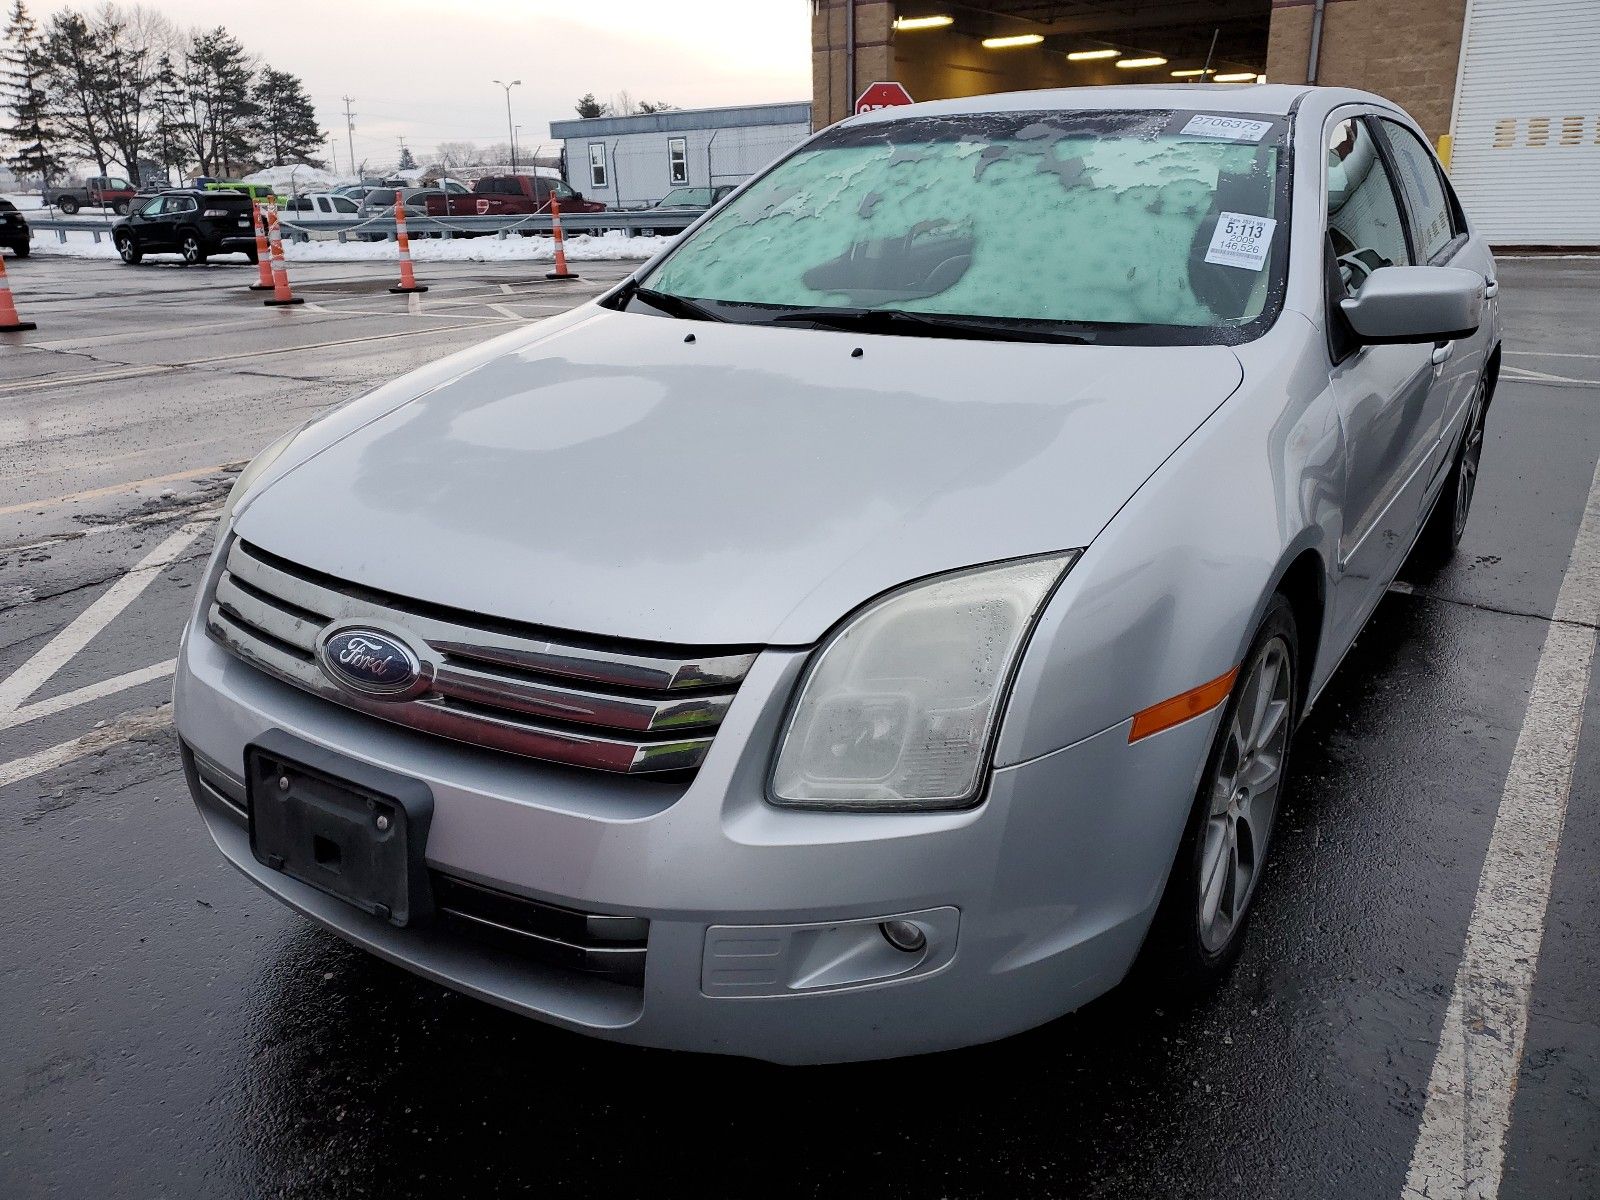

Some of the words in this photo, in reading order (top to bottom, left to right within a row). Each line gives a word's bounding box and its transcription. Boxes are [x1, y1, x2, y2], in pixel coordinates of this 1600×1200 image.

[1191, 116, 1262, 131] 2706375
[1225, 221, 1263, 239] 5:113
[1220, 240, 1260, 254] 146,526
[1230, 234, 1255, 245] 2009
[339, 637, 393, 676] Ford
